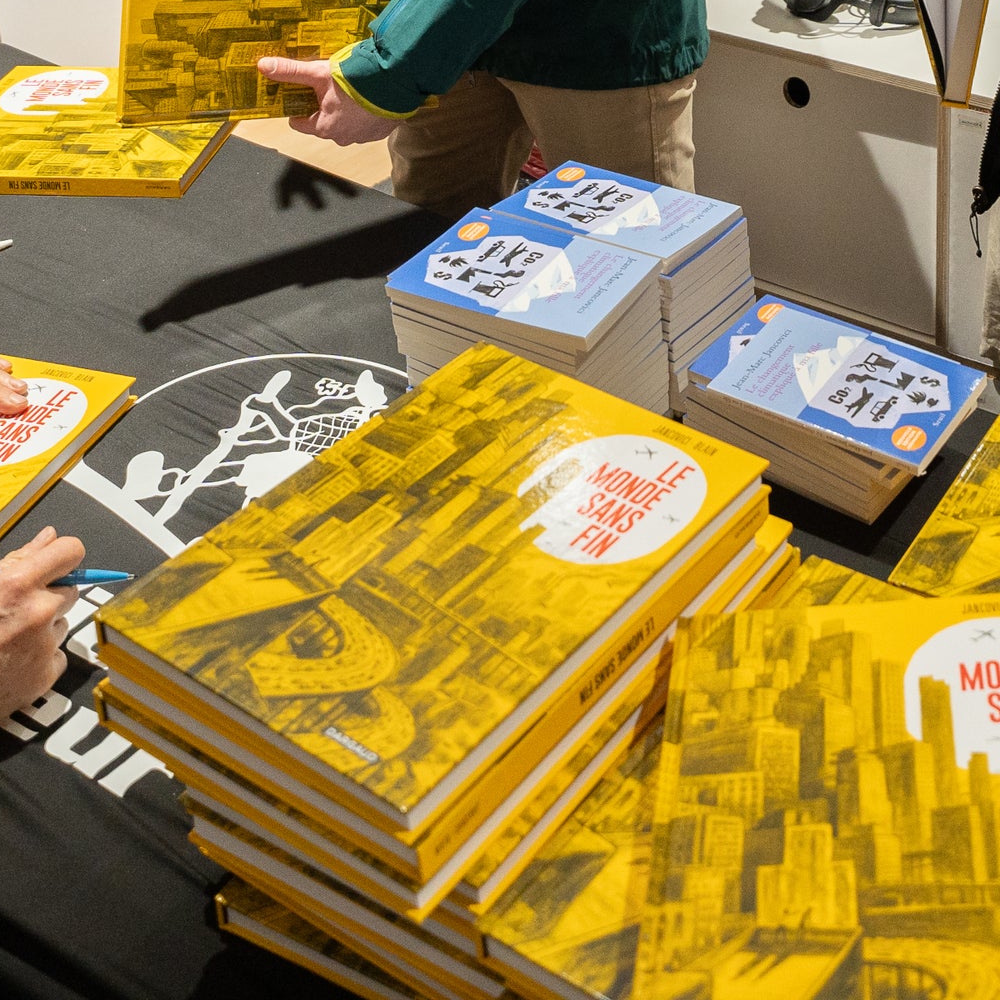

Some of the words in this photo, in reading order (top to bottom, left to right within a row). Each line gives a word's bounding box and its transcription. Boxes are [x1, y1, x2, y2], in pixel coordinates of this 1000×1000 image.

[8, 180, 20, 190] FIN
[20, 180, 38, 190] SANS
[39, 181, 62, 191] MONDE
[62, 181, 71, 191] LE
[731, 355, 766, 391] Jean-Marc
[762, 328, 793, 359] Jancovici
[46, 389, 78, 408] LE
[583, 461, 672, 511] MONDE
[655, 460, 697, 490] LE
[576, 491, 646, 534] SANS
[568, 524, 621, 559] FIN
